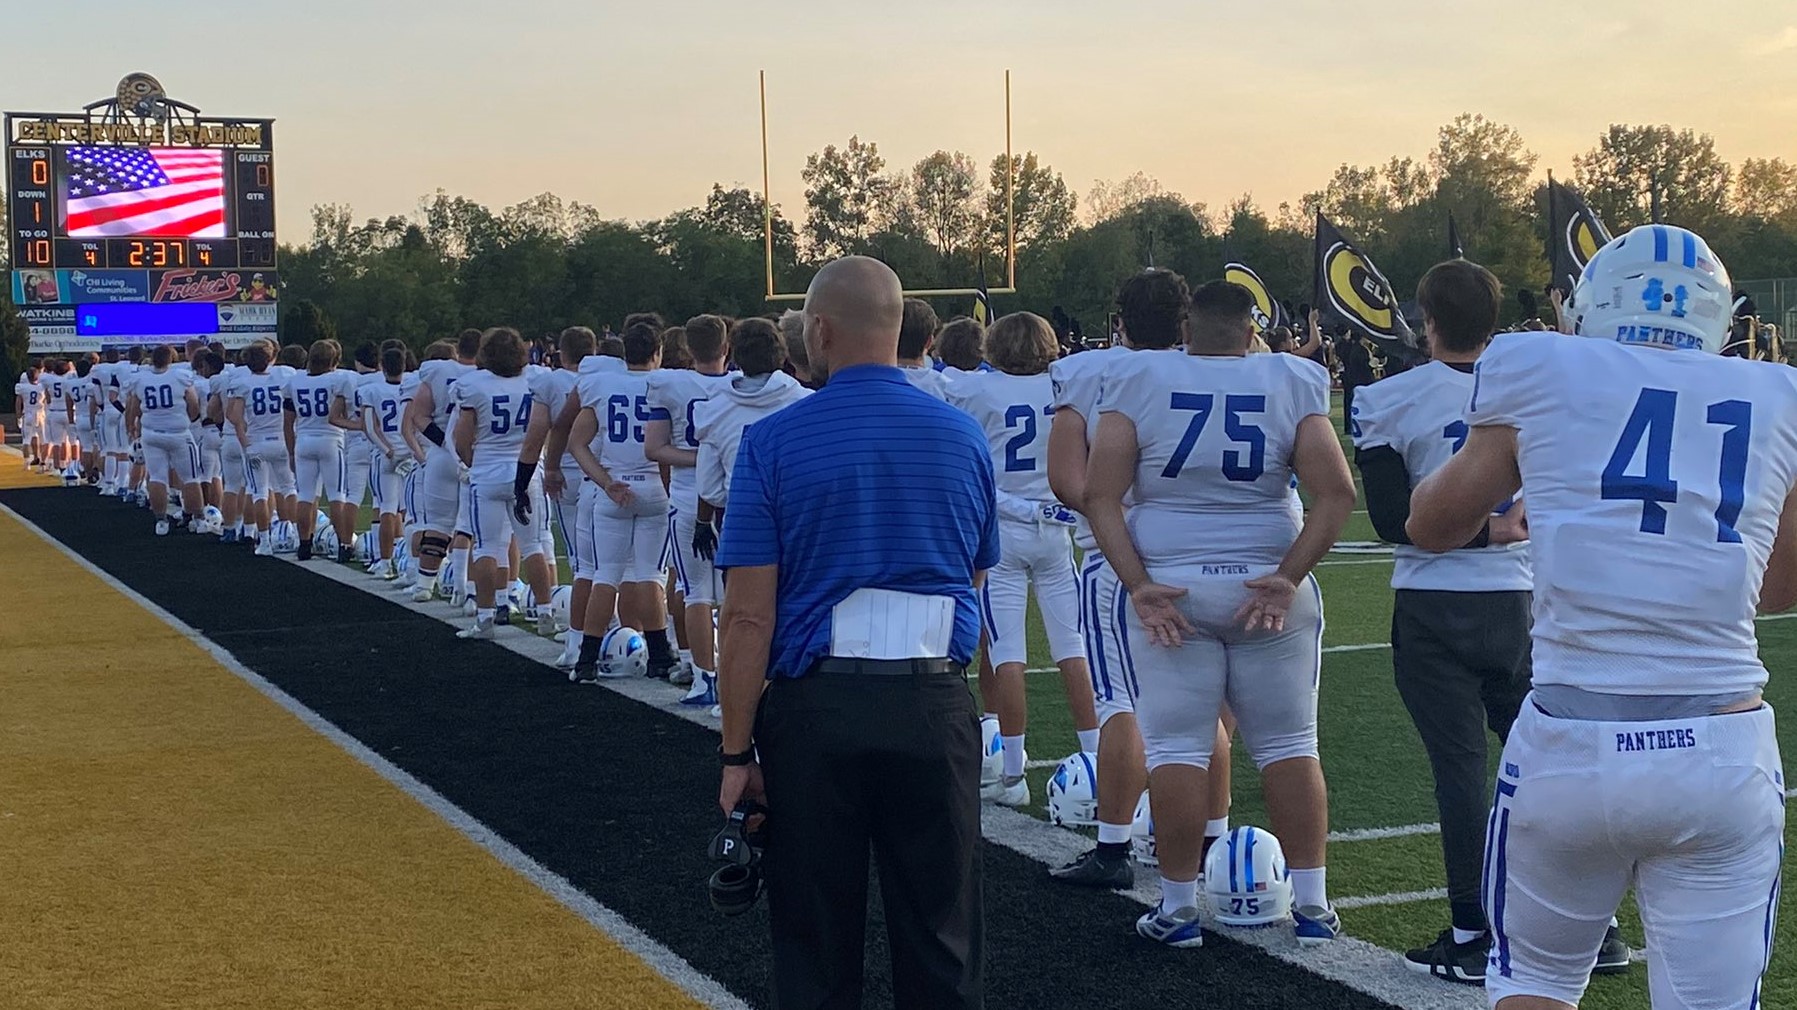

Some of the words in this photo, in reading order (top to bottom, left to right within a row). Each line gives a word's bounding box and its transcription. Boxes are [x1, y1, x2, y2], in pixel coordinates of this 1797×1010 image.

[18, 121, 164, 143] CENTERVILLE
[172, 125, 262, 145] STADIUM
[16, 150, 46, 158] ELKS
[238, 154, 269, 162] GUEST
[33, 161, 47, 184] 0
[35, 201, 40, 224] 1
[27, 241, 49, 264] 10
[86, 251, 95, 265] 4
[130, 242, 183, 265] 2:37
[200, 251, 209, 265] 4
[101, 279, 125, 288] Living
[1616, 326, 1703, 350] PANTHERS
[30, 391, 38, 405] 8
[54, 382, 62, 398] 5
[144, 384, 174, 409] 60
[252, 385, 282, 415] 85
[297, 388, 328, 417] 58
[491, 394, 532, 435] 54
[608, 394, 650, 443] 65
[1161, 392, 1266, 482] 75
[1601, 387, 1752, 544] 41
[1202, 564, 1249, 575] PANTHERS
[1616, 727, 1696, 752] PANTHERS
[722, 838, 734, 855] P
[1231, 897, 1259, 916] 75
